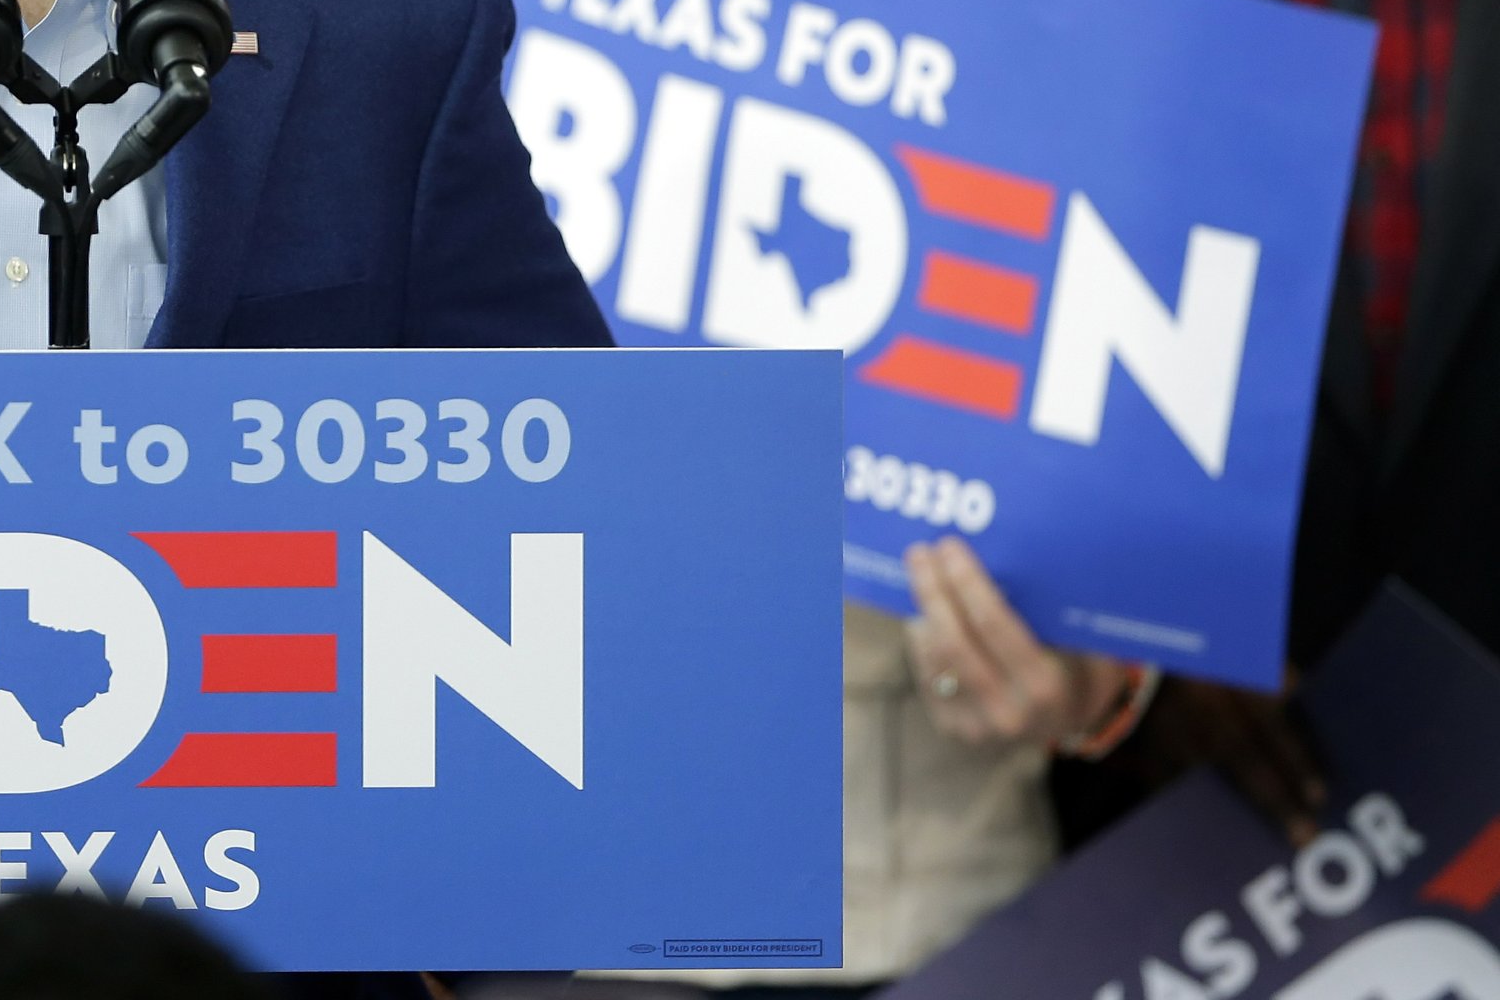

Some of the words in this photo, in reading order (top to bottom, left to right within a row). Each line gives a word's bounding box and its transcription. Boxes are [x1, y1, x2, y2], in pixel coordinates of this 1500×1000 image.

[776, 1, 957, 128] FOR
[503, 27, 1261, 480] BIDEN
[73, 409, 189, 484] to
[231, 398, 571, 484] 30330
[844, 445, 996, 535] 30330
[1240, 792, 1424, 958] FOR
[668, 945, 690, 953] PAID
[691, 945, 709, 953] FOR
[710, 945, 722, 953] BY
[723, 944, 750, 953] BIDEN
[751, 944, 769, 953] FOR
[770, 944, 818, 953] PRESIDENT
